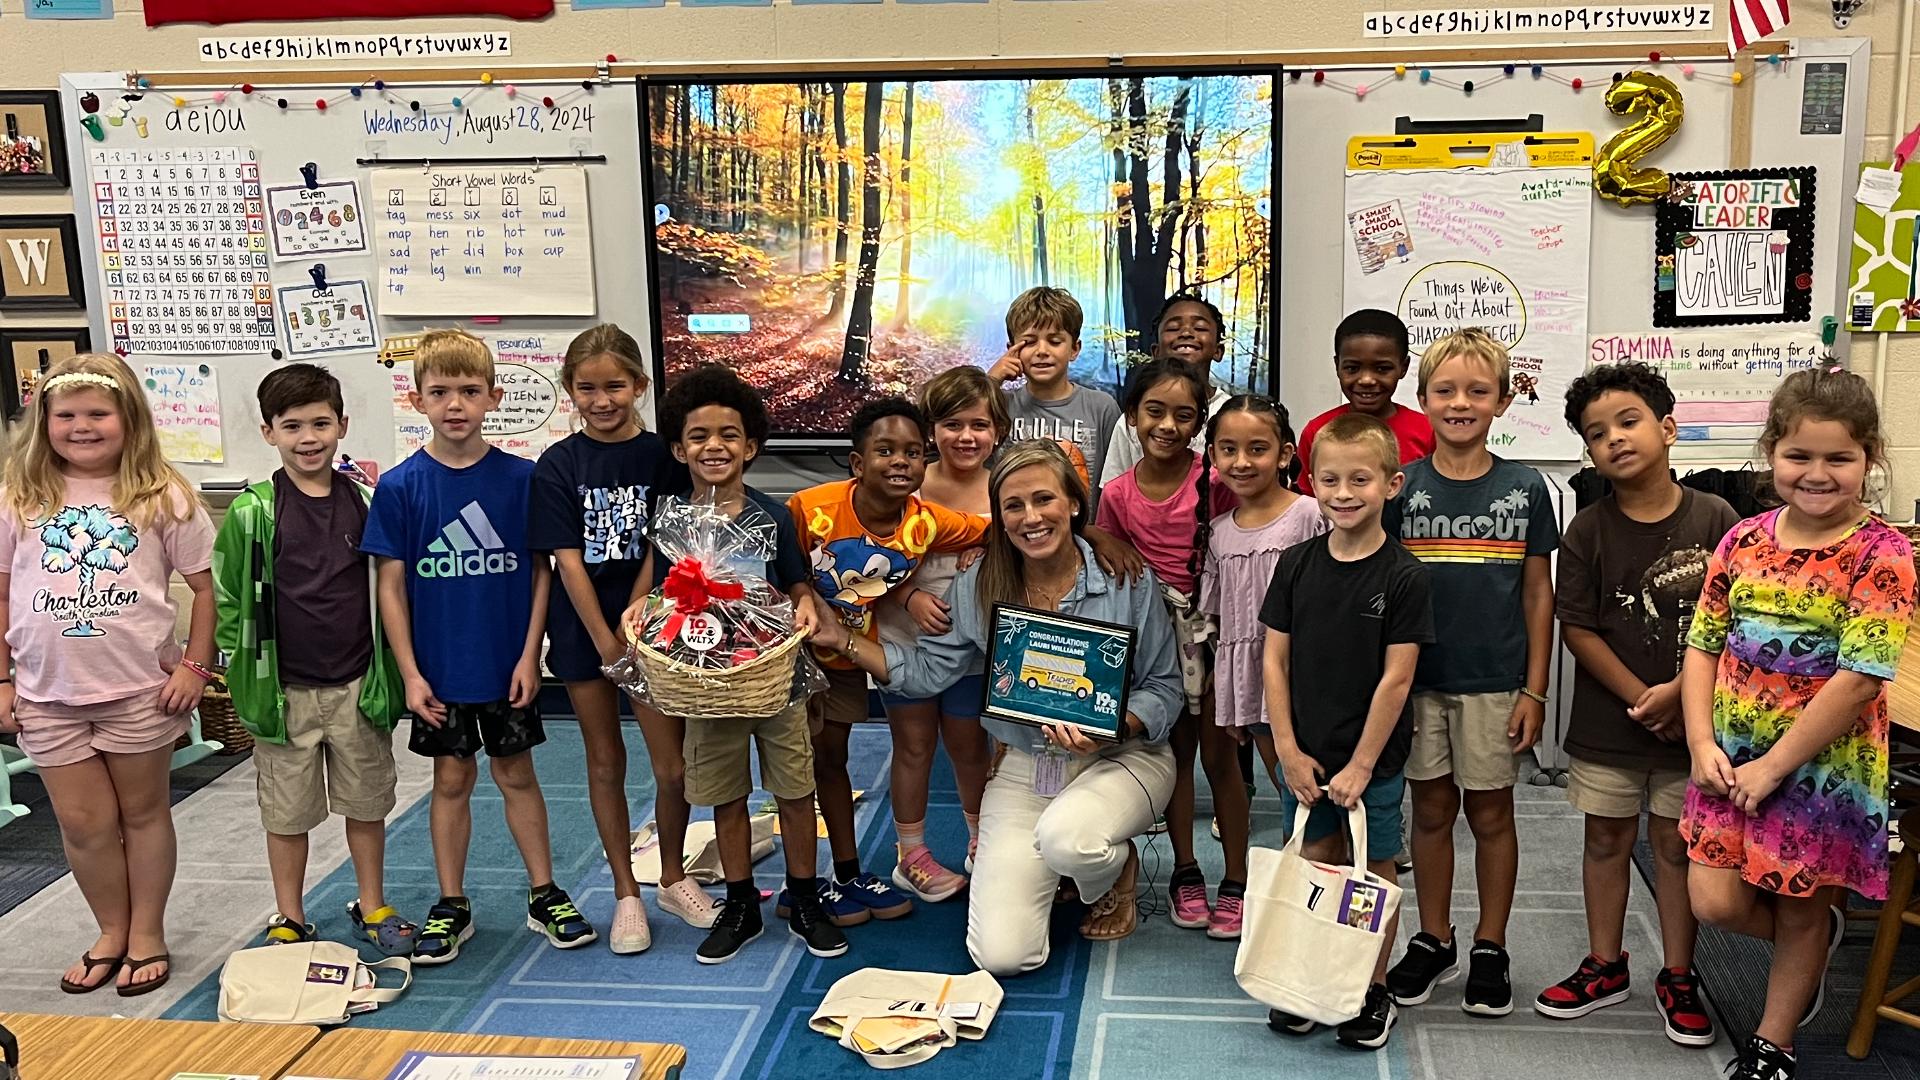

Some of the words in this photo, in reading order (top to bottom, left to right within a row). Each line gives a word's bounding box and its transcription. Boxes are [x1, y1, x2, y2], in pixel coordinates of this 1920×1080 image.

[464, 108, 515, 143] August
[550, 104, 597, 133] 2024
[1592, 71, 1682, 207] 2
[432, 174, 462, 188] Short
[466, 172, 496, 186] Vowel
[500, 170, 536, 184] Words
[300, 189, 326, 200] Even
[1522, 190, 1562, 201] author
[102, 205, 113, 214] 21
[118, 205, 130, 214] 22
[134, 205, 146, 214] 23
[151, 204, 162, 214] 24
[168, 204, 179, 214] 25
[184, 204, 196, 213] 26
[200, 204, 212, 213] 27
[218, 203, 228, 213] 28
[233, 203, 244, 213] 29
[249, 203, 260, 212] 30
[295, 212, 308, 229] 2
[310, 207, 324, 224] 4
[328, 210, 341, 227] 6
[343, 204, 355, 222] 8
[386, 209, 406, 224] tag
[427, 211, 453, 220] mess
[464, 208, 480, 219] six
[502, 206, 523, 219] dot
[543, 207, 566, 219] mud
[1695, 205, 1769, 227] LEADER
[1358, 218, 1402, 237] SCHOOL
[1365, 213, 1391, 226] SMART
[389, 231, 411, 243] map
[430, 226, 448, 239] hen
[467, 227, 484, 238] rib
[505, 224, 526, 238] hot
[545, 228, 566, 237] run
[390, 246, 410, 257] sad
[431, 247, 449, 260] pet
[464, 244, 485, 256] did
[505, 242, 524, 257] box
[544, 246, 564, 257] cup
[7, 239, 51, 286] W
[390, 265, 408, 275] mat
[431, 262, 445, 281] leg
[465, 265, 482, 275] win
[504, 265, 522, 279] mop
[112, 290, 124, 300] 71
[128, 290, 140, 300] 72
[145, 290, 156, 300] 73
[162, 290, 172, 300] 74
[178, 290, 189, 300] 75
[194, 289, 206, 300] 76
[210, 289, 221, 299] 77
[226, 289, 238, 299] 78
[242, 289, 254, 299] 79
[258, 289, 270, 299] 80
[312, 288, 334, 298] Odd
[387, 278, 405, 296] tap
[1424, 278, 1464, 304] Things
[1471, 276, 1504, 295] We've
[302, 307, 314, 325] 3
[333, 304, 345, 320] 7
[350, 305, 365, 320] 9
[1409, 299, 1439, 320] Found
[1445, 300, 1466, 321] Out
[1471, 297, 1514, 318] About
[497, 337, 543, 350] resourceful
[1592, 336, 1674, 361] STAMINA
[1681, 347, 1690, 358] is
[1697, 342, 1725, 364] doing
[1732, 341, 1780, 363] anything
[1787, 343, 1800, 355] for
[1809, 345, 1816, 355] a
[1699, 360, 1739, 370] without
[1746, 359, 1783, 377] getting
[1786, 358, 1814, 369] tired
[1012, 417, 1084, 444] RULE
[583, 487, 611, 511] IN
[616, 485, 650, 505] MY
[416, 548, 518, 578] adidas
[33, 583, 139, 613] Charleston
[53, 610, 79, 621] South
[83, 608, 119, 620] Carolina
[688, 635, 715, 645] WLTX
[1029, 631, 1090, 649] CONGRATULATIONS
[1029, 640, 1050, 651] LAURI
[1051, 643, 1085, 657] WILLIAMS
[1094, 704, 1117, 716] WLTX
